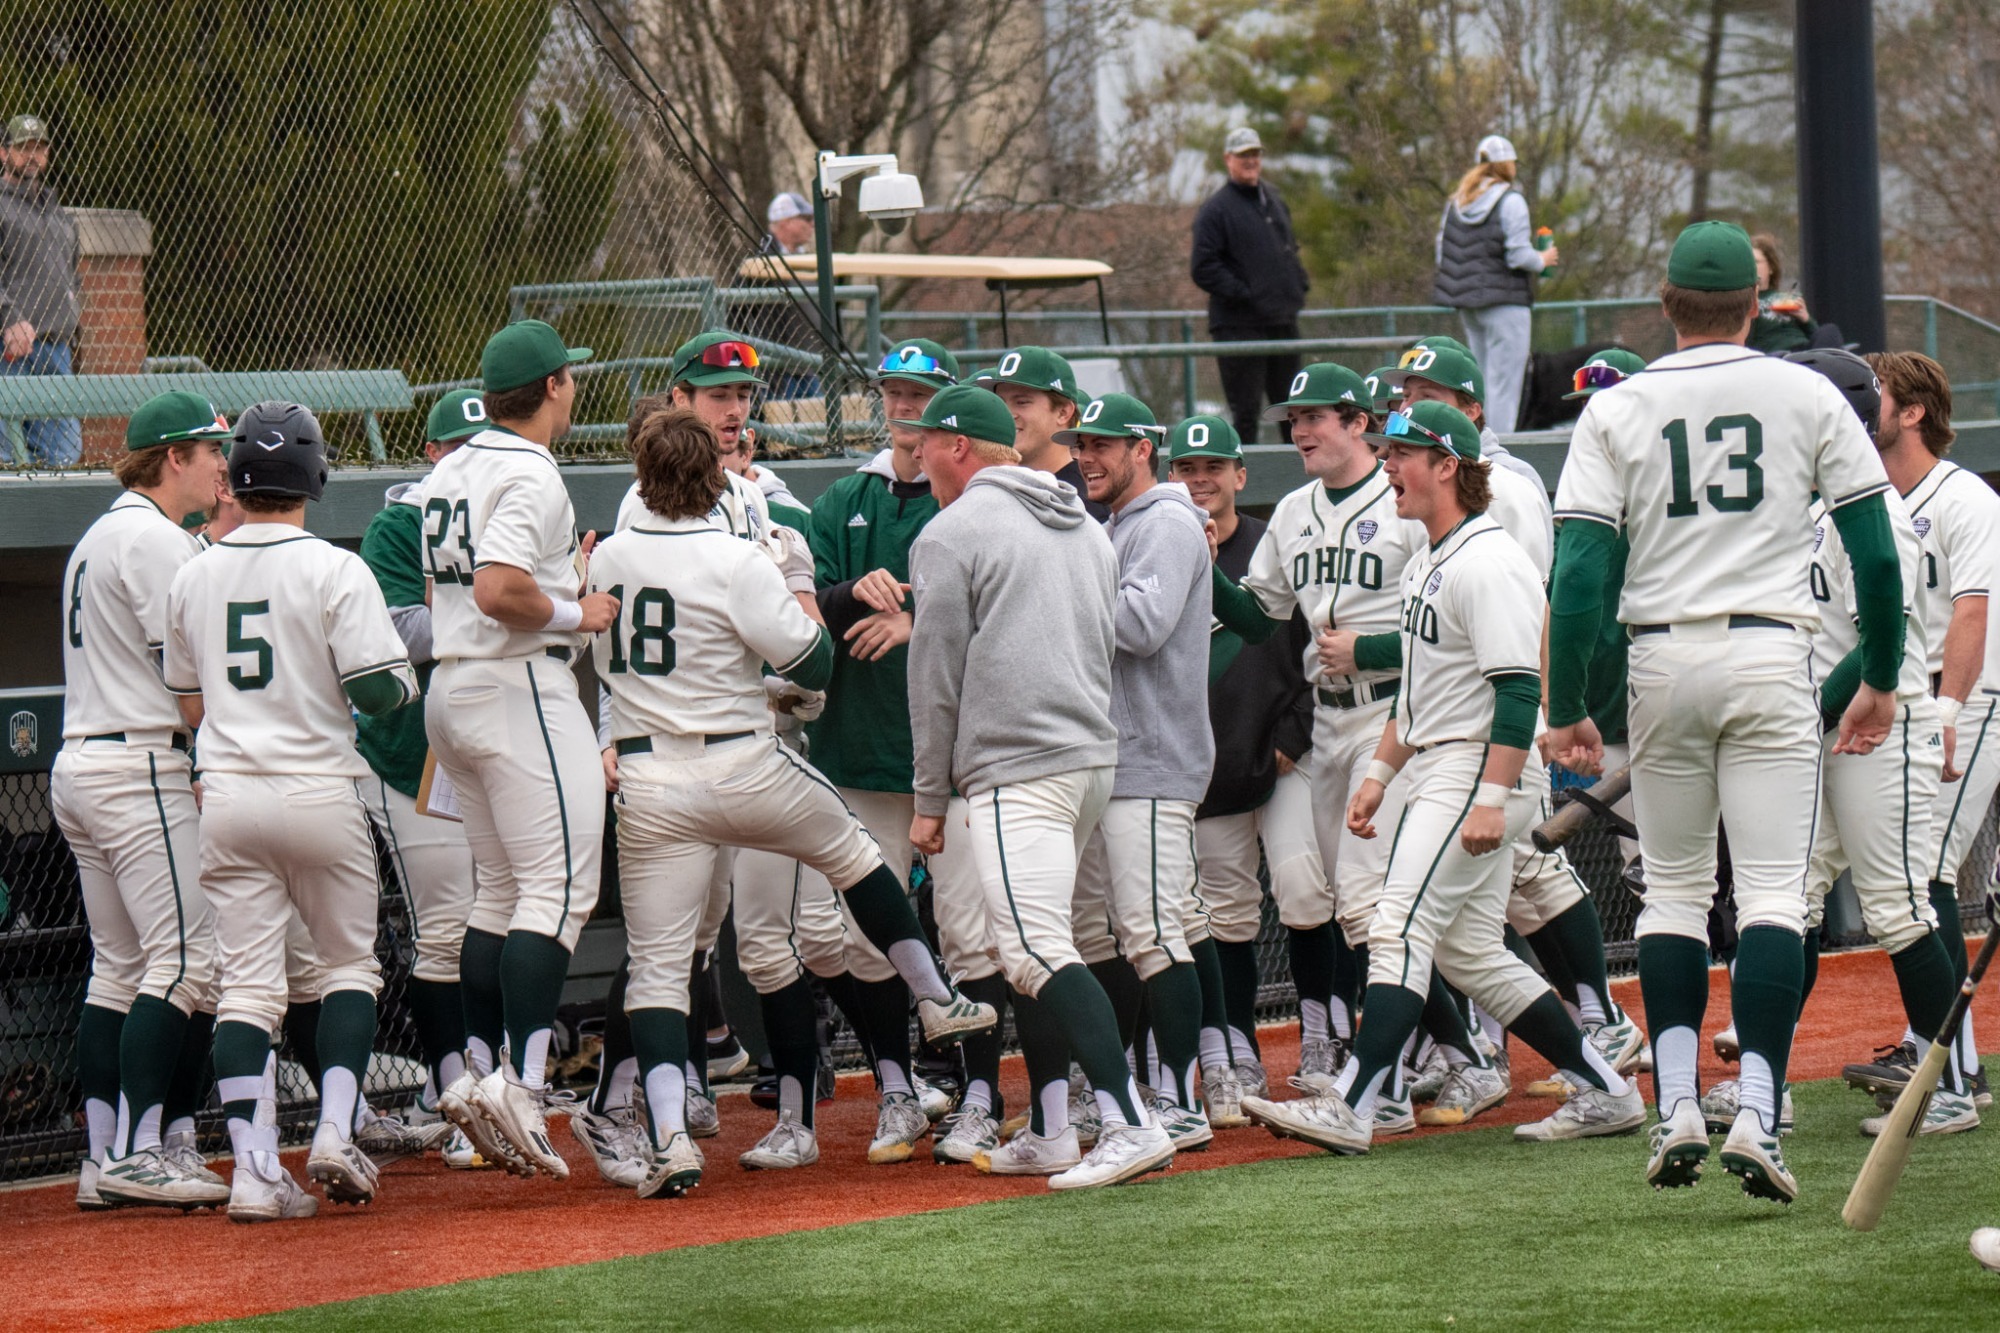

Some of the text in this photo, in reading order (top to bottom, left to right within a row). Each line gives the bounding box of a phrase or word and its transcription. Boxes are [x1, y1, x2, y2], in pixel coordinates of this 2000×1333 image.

[999, 353, 1021, 376] O
[1413, 351, 1437, 371] O
[1290, 372, 1309, 396] O
[462, 398, 486, 422] O
[1082, 400, 1104, 422] O
[1188, 424, 1208, 447] O
[1662, 413, 1764, 518] 13
[244, 473, 251, 485] 5
[424, 498, 475, 587] 23
[1293, 547, 1382, 591] OHIO
[608, 584, 676, 676] 18
[1401, 595, 1439, 645] HIO
[227, 600, 273, 690] 5
